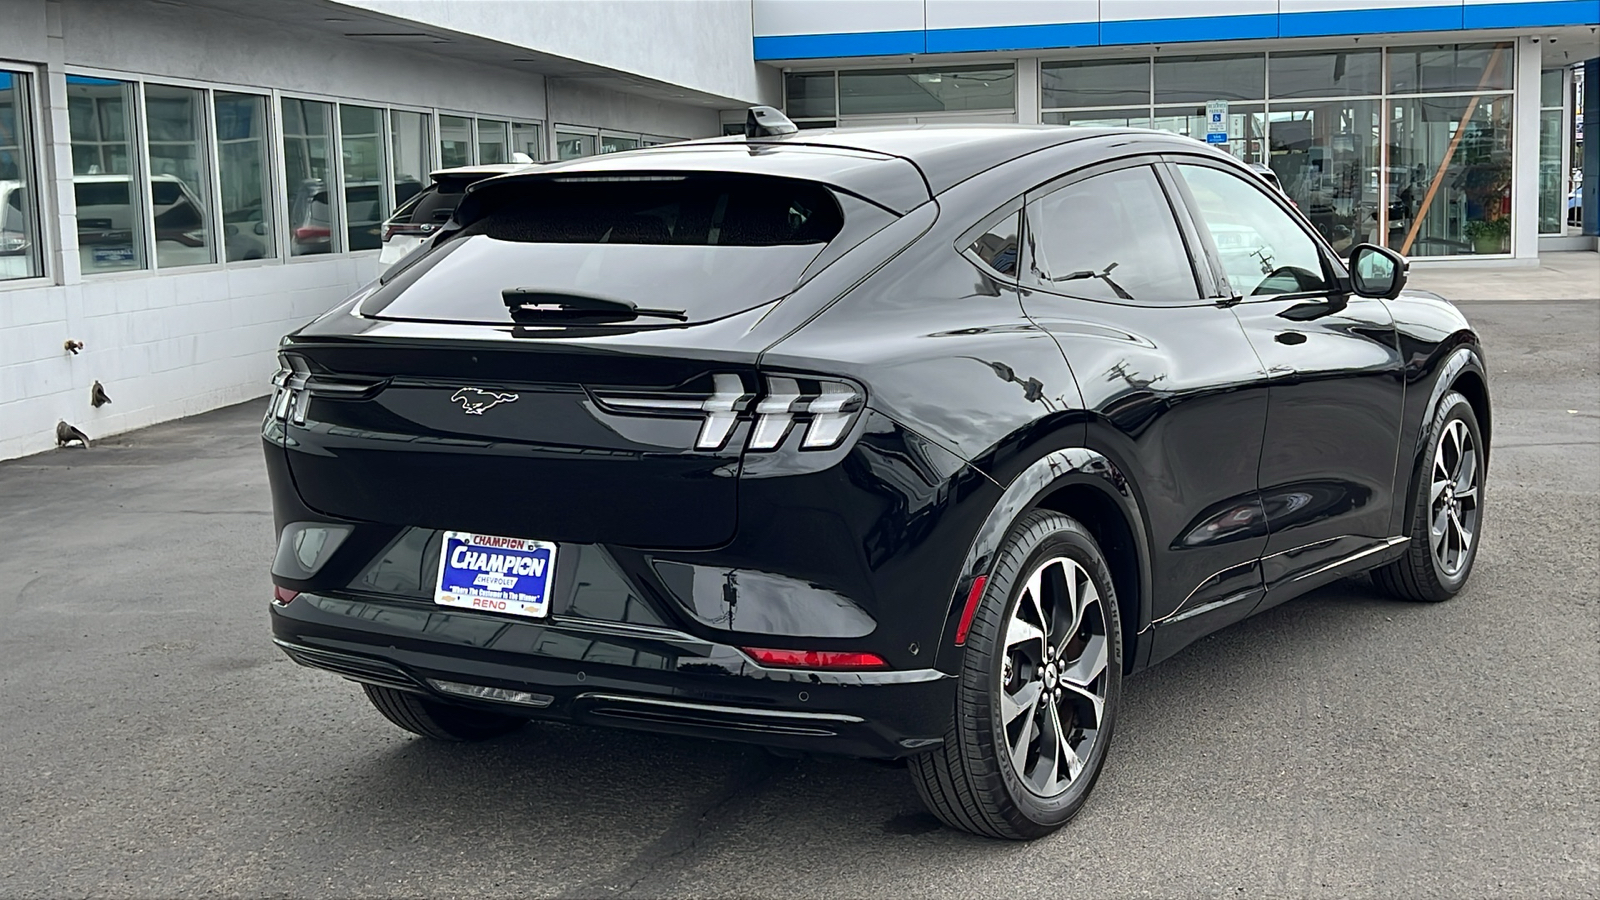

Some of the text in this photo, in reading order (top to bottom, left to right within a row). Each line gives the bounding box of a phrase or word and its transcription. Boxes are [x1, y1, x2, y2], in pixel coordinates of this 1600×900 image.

[473, 535, 525, 549] CHAMPION
[450, 545, 546, 578] CHAMPION
[477, 576, 514, 586] CHEVROLET
[472, 598, 507, 610] RENO
[1103, 581, 1121, 658] MICHELIN
